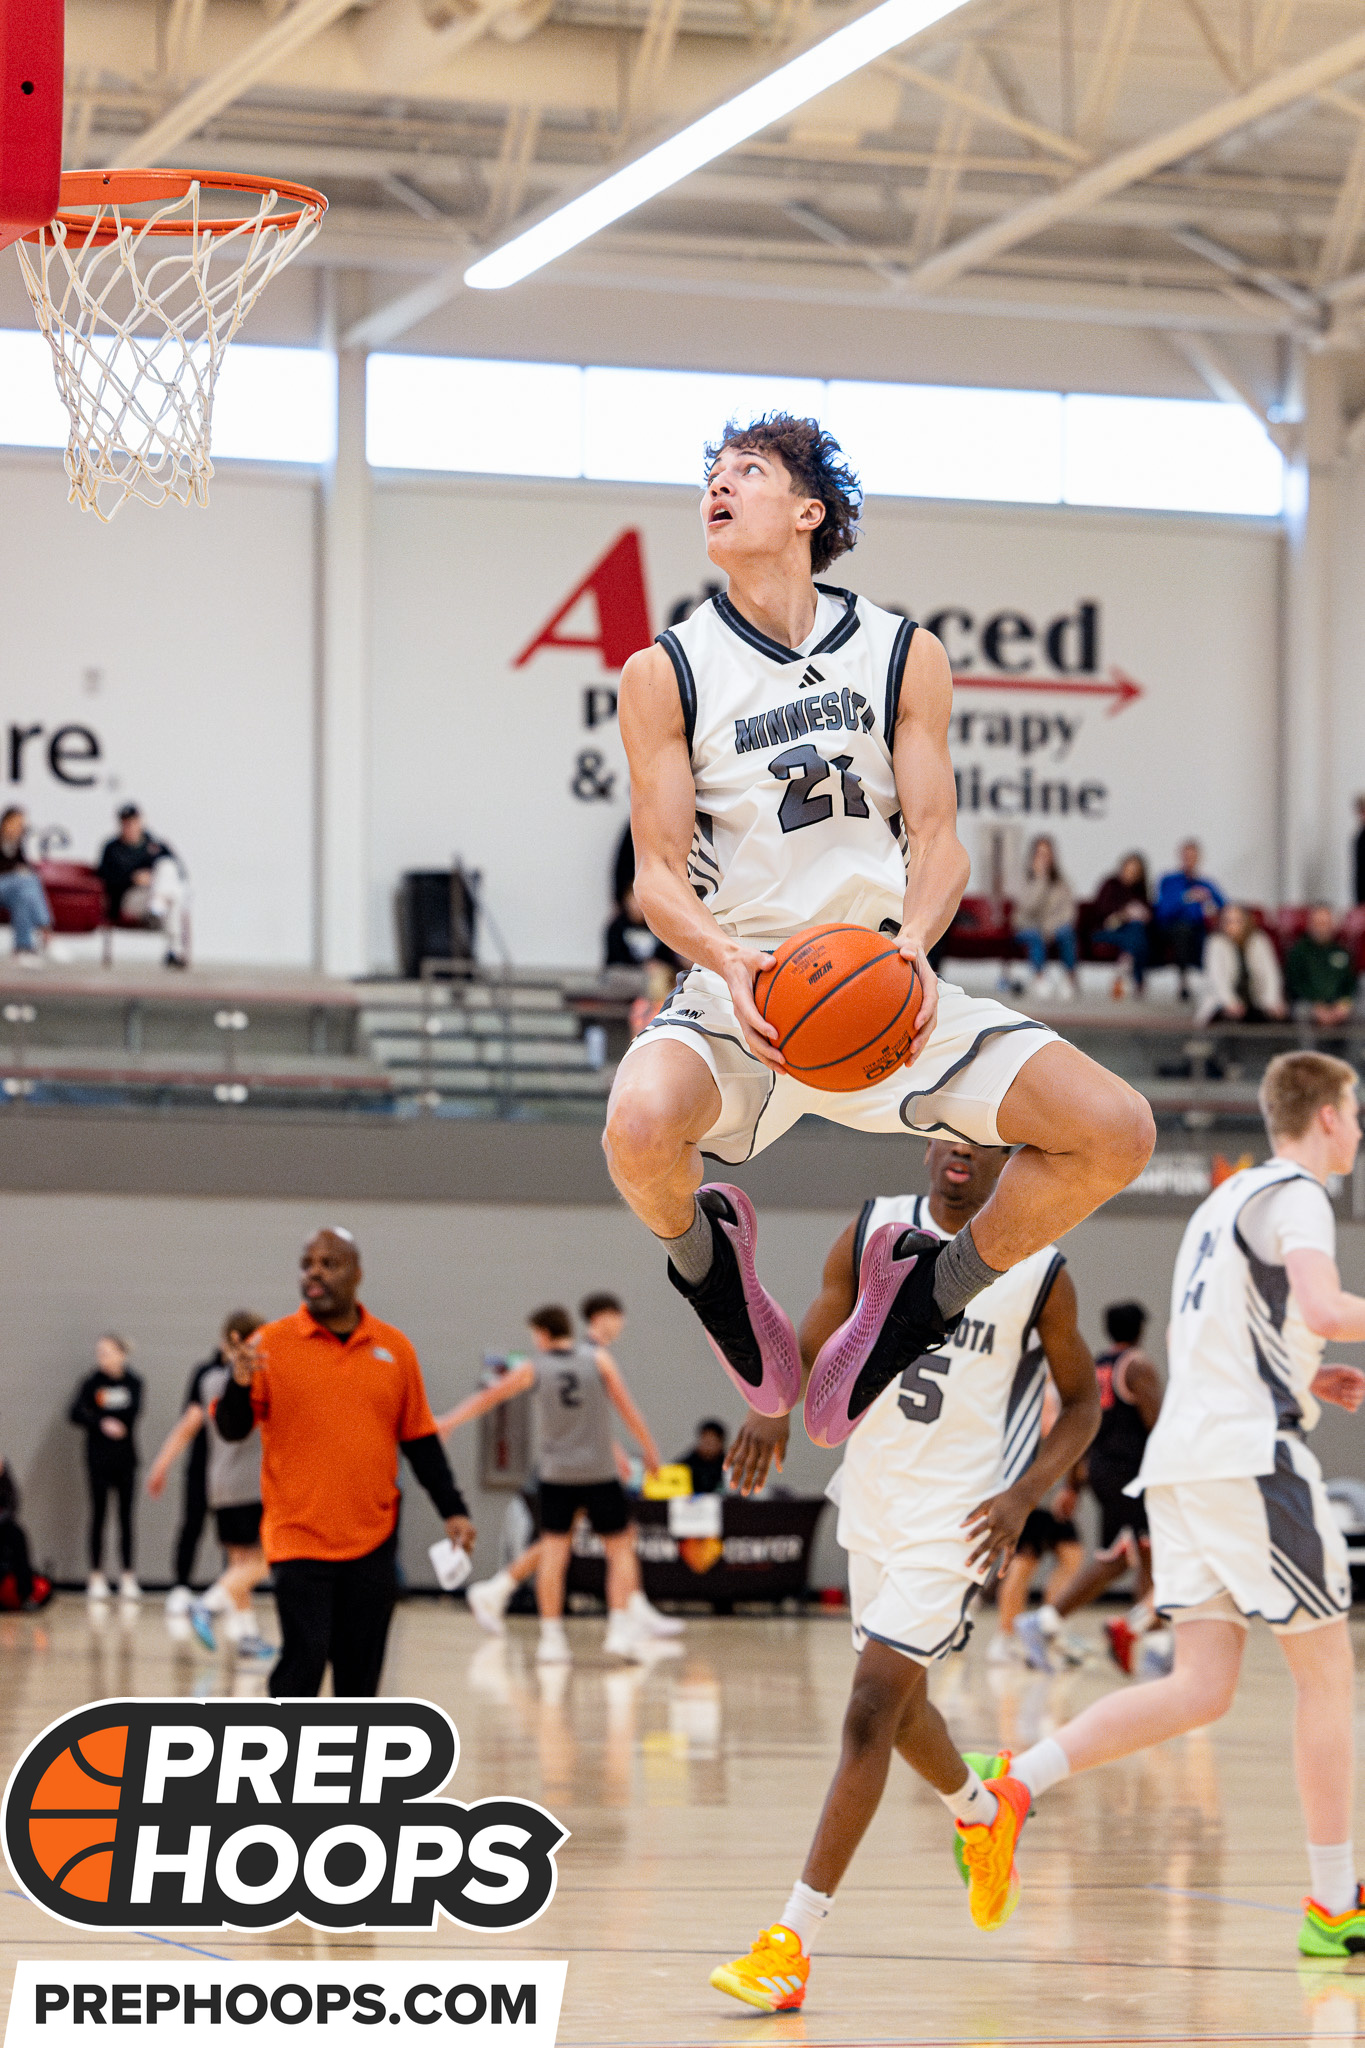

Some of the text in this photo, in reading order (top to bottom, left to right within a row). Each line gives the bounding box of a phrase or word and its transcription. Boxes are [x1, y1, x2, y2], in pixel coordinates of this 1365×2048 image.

[572, 751, 616, 801] &
[768, 744, 870, 834] 21
[558, 1371, 580, 1408] 2
[897, 1353, 952, 1425] 5
